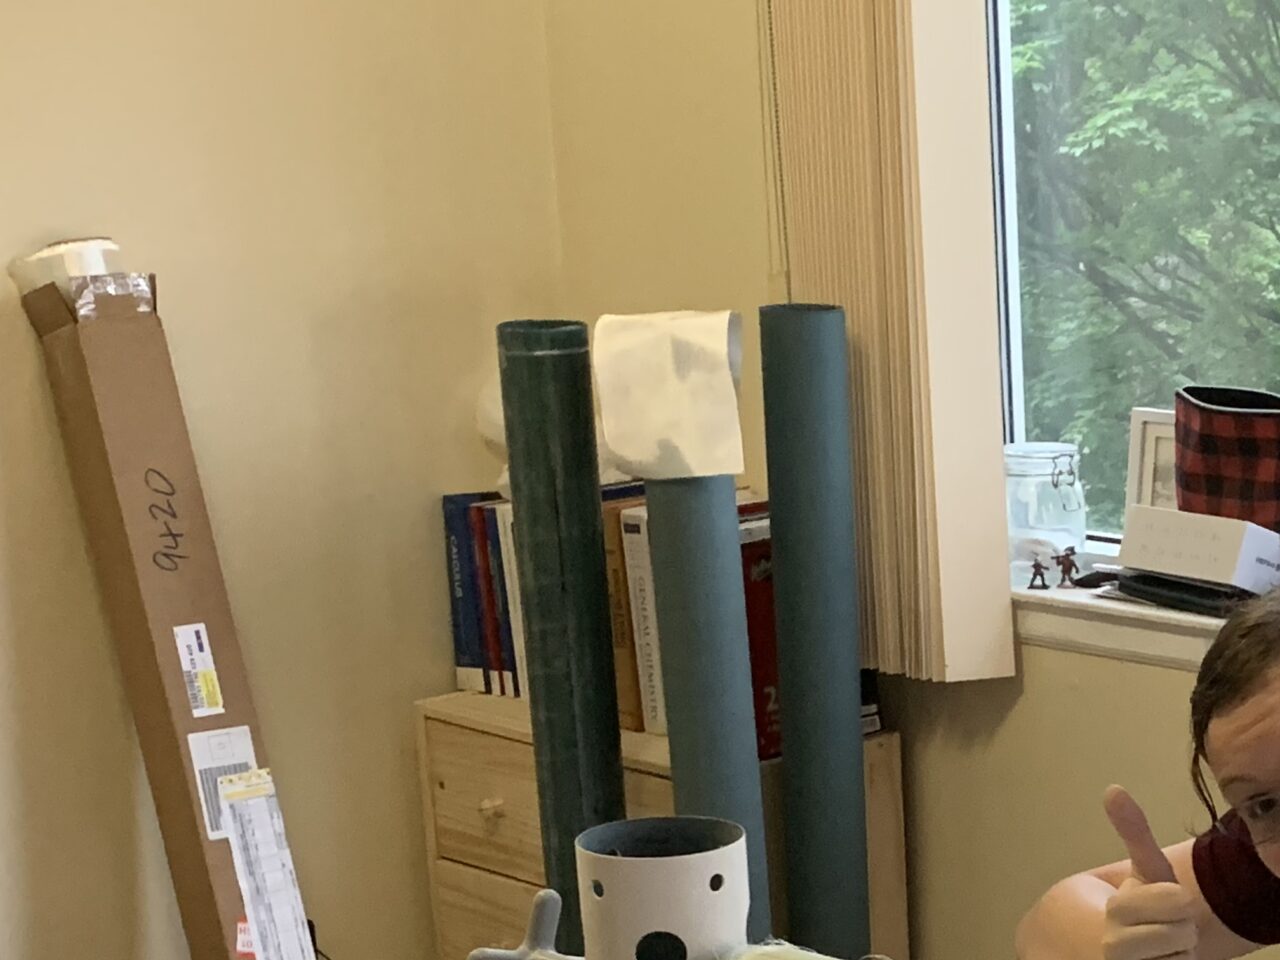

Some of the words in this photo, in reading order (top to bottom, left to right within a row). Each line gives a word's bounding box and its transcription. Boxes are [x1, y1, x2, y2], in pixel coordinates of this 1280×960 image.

[144, 467, 190, 572] 9420
[638, 576, 651, 637] GENERAL
[645, 642, 658, 722] CHEMISTRY
